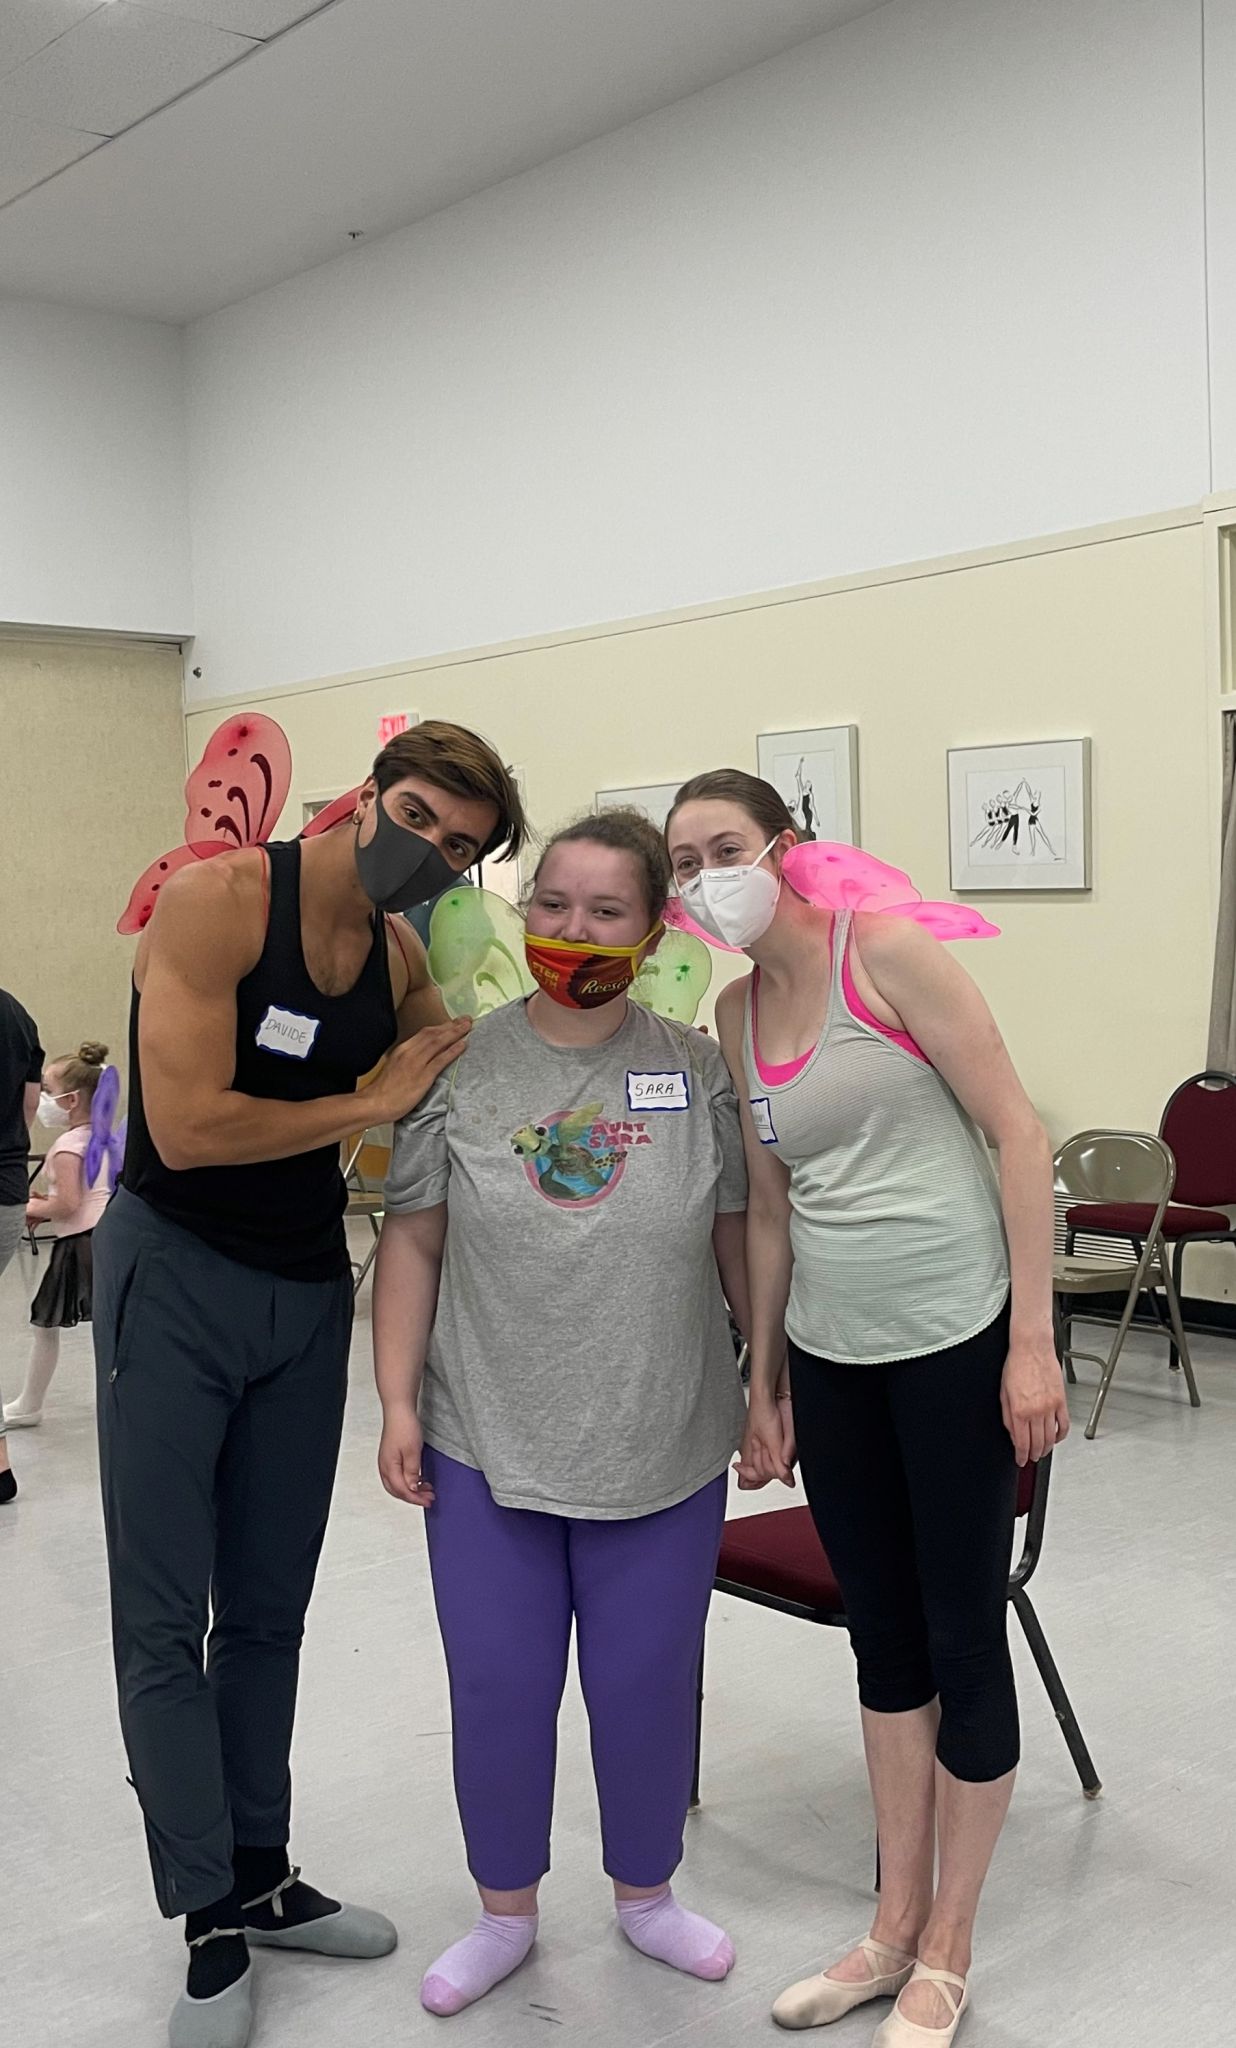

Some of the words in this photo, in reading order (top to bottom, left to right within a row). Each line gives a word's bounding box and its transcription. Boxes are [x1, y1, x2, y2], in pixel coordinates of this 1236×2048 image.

[265, 1019, 307, 1044] DAVIDE
[635, 1082, 674, 1097] SARA
[592, 1120, 646, 1135] AUNT
[589, 1133, 653, 1149] SARA
